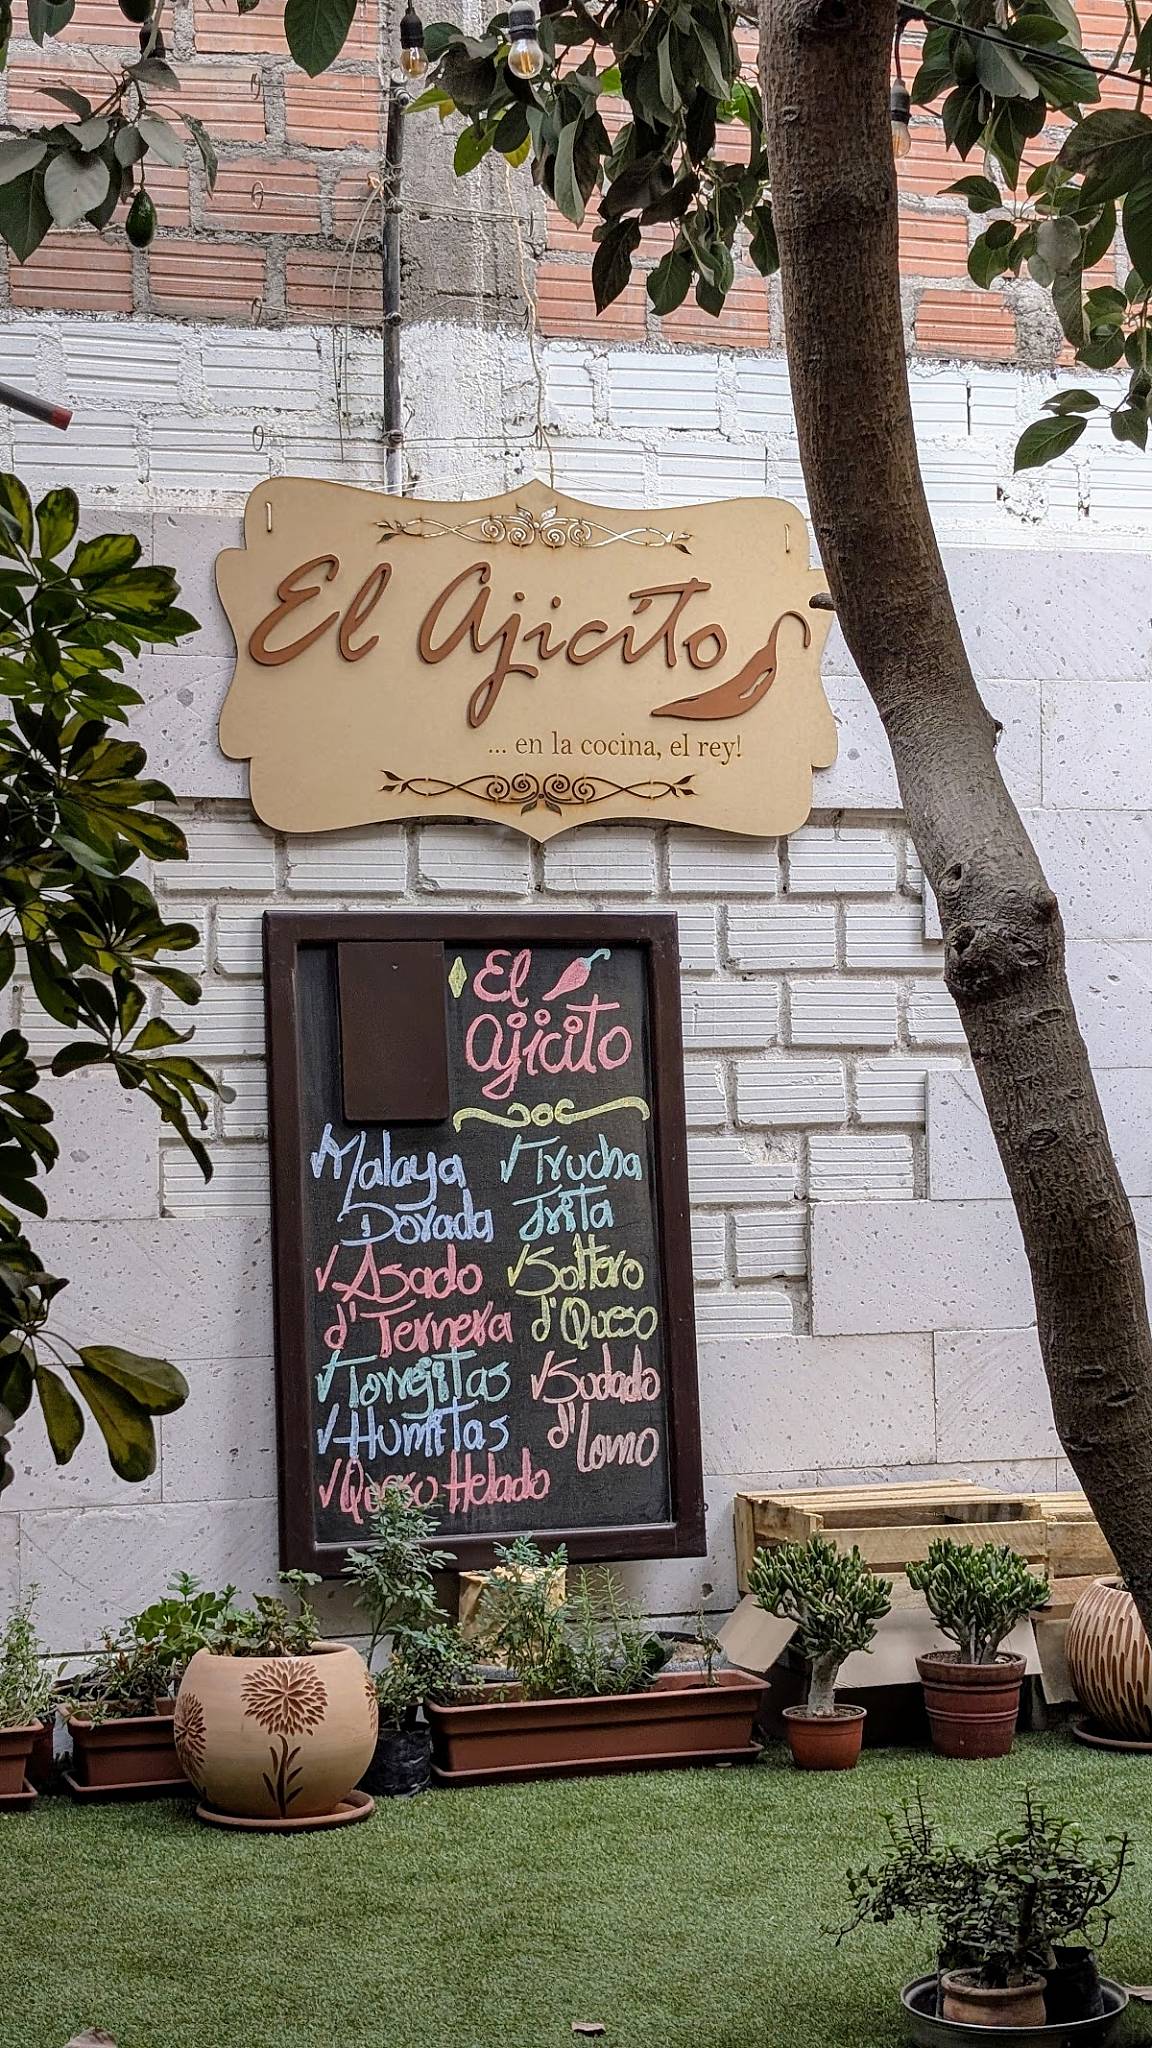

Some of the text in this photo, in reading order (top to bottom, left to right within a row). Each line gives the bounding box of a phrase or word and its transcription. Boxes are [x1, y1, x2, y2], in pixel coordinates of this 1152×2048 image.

[248, 553, 729, 729] El Ajicito
[515, 737, 543, 755] en
[552, 731, 572, 755] la
[581, 732, 662, 760] cocina,
[670, 733, 690, 757] el
[698, 734, 742, 765] rey!
[473, 949, 532, 1008] El
[311, 1123, 468, 1214] Malaya
[514, 1133, 644, 1185] Trucha
[338, 1187, 495, 1246] Dorada
[332, 1243, 484, 1304] Asado
[542, 1342, 662, 1405] Sudado
[332, 1396, 511, 1461] Humitas
[442, 1447, 551, 1514] Helado
